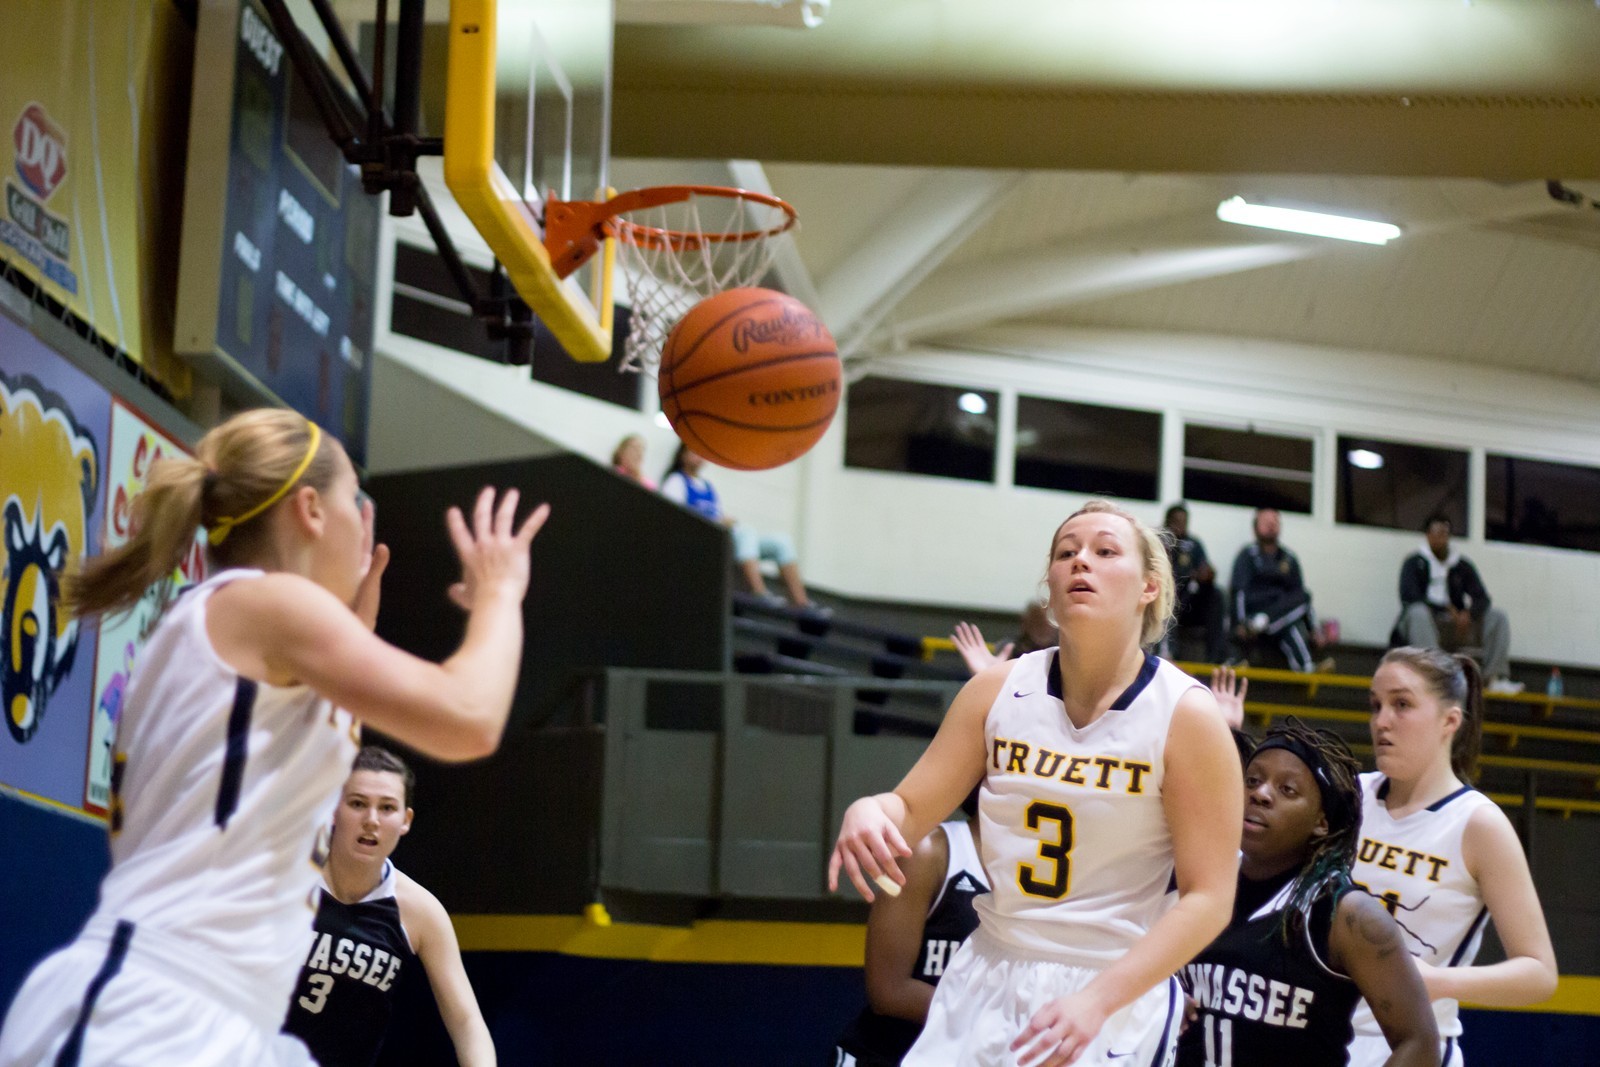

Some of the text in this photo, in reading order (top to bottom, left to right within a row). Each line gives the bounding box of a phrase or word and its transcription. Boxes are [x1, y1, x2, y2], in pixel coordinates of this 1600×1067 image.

[242, 6, 283, 76] GUEST
[20, 117, 62, 191] DQ
[993, 737, 1152, 794] TRUETT
[1016, 799, 1077, 901] 3
[299, 973, 335, 1015] 3
[1203, 1013, 1233, 1067] 11
